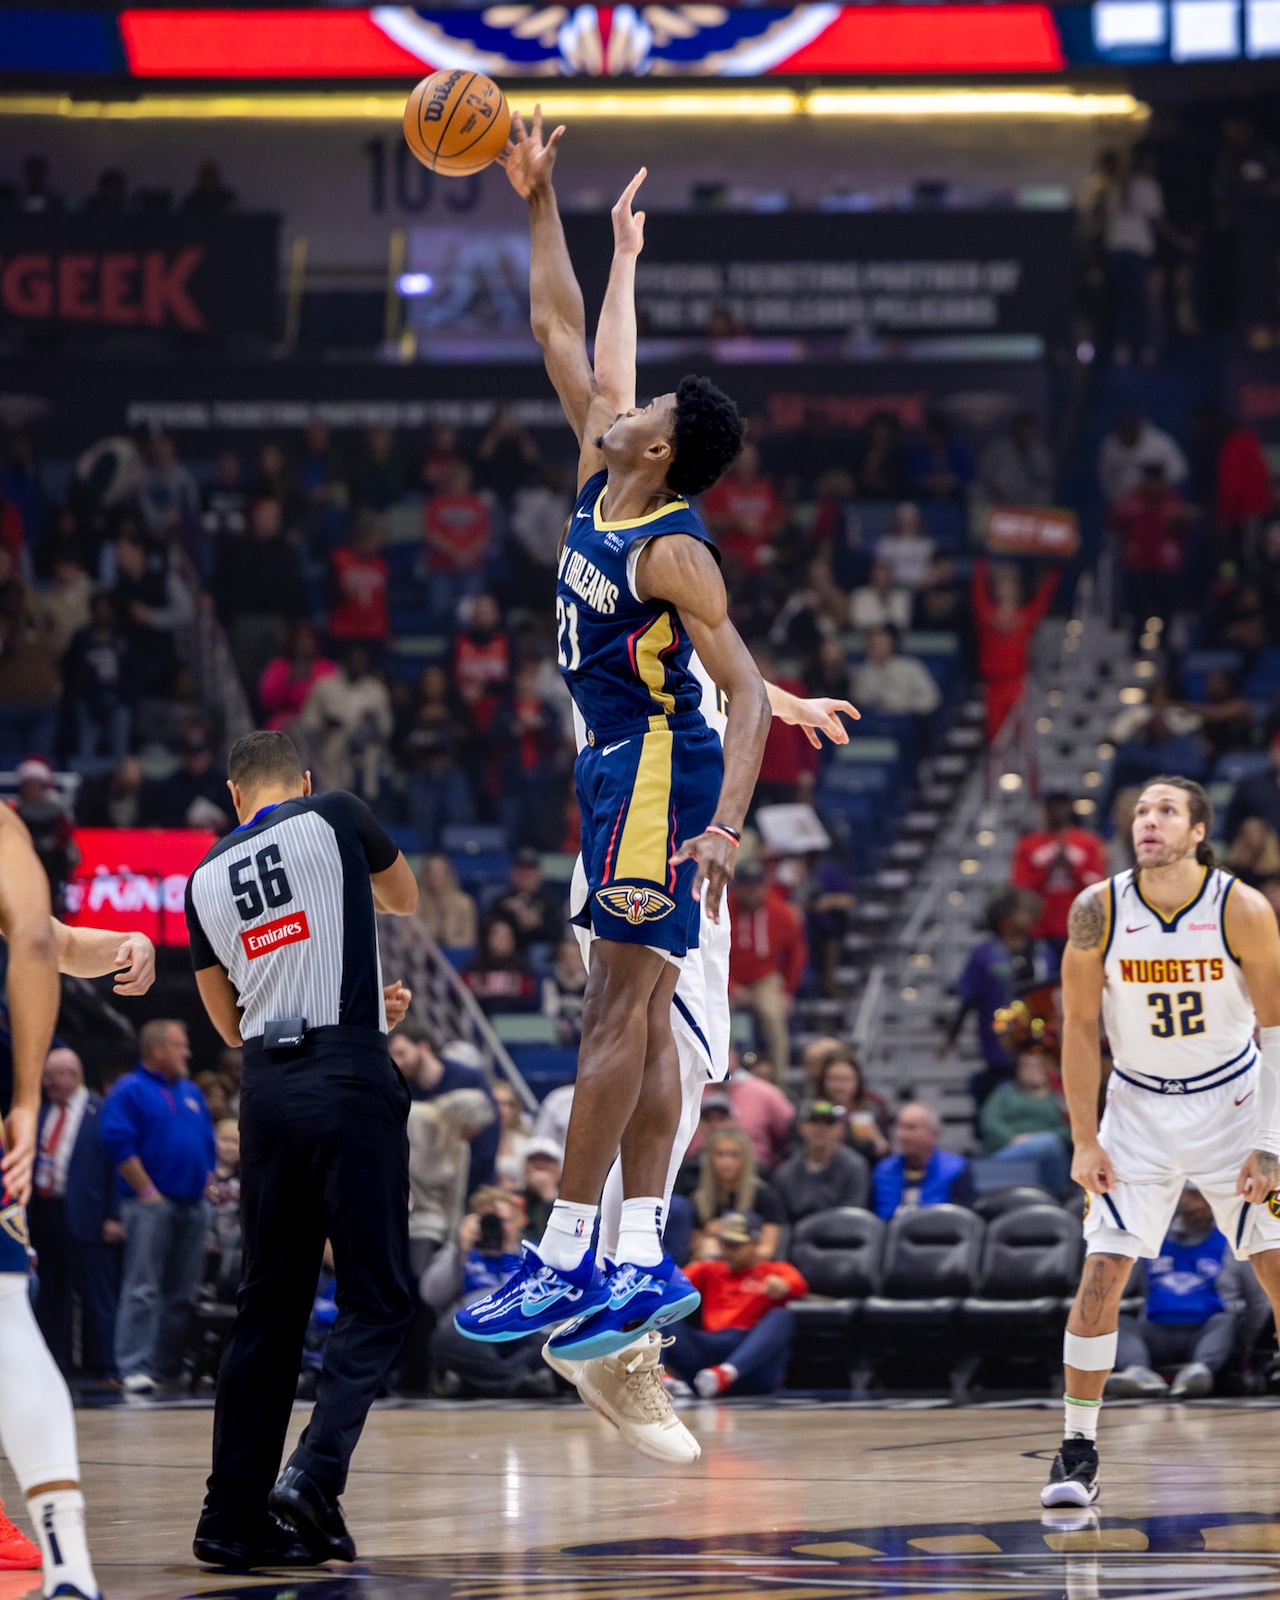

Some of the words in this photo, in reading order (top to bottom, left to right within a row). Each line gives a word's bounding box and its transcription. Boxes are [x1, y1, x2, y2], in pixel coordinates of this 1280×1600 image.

[0, 247, 205, 332] GEEK
[565, 551, 619, 614] ORLEANS
[556, 596, 580, 671] 21
[228, 844, 293, 921] 56
[247, 921, 302, 951] Emirates
[1119, 958, 1224, 983] NUGGETS
[1147, 990, 1206, 1038] 32
